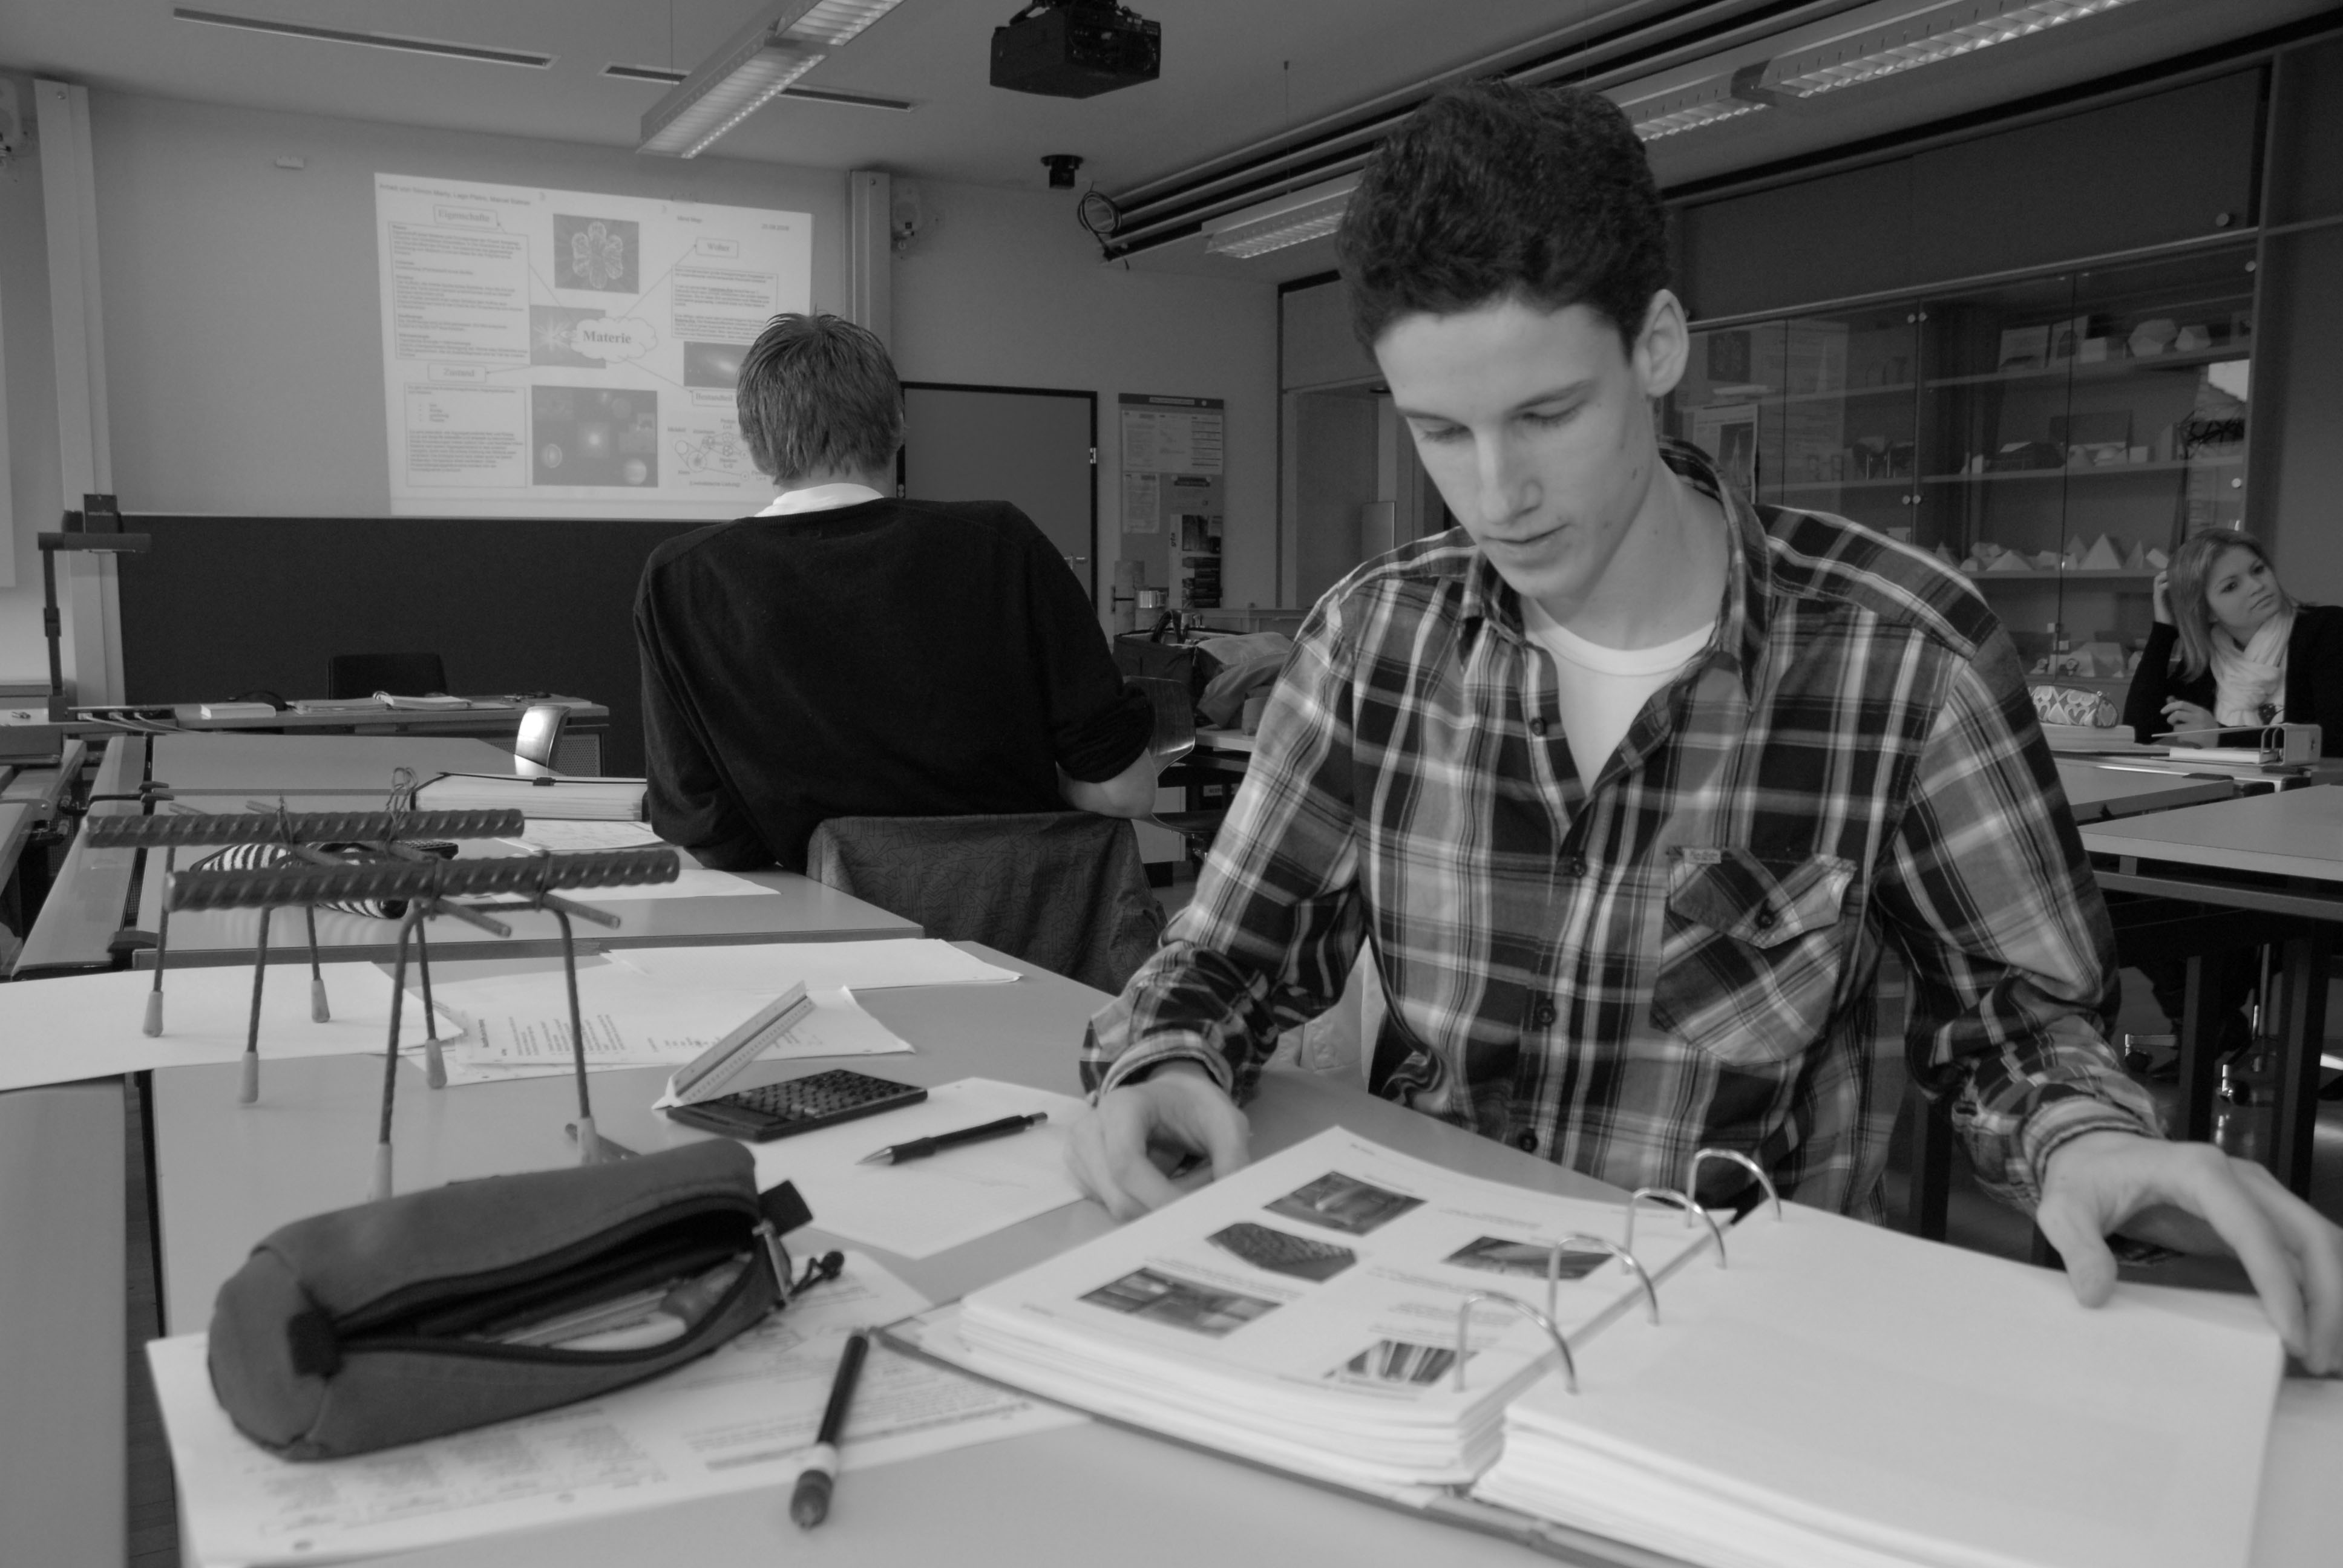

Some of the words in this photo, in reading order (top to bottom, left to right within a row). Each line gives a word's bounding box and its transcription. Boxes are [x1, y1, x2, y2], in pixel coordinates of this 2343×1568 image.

[706, 241, 730, 252] Woher
[583, 330, 632, 344] Materie
[443, 367, 475, 377] Zustand
